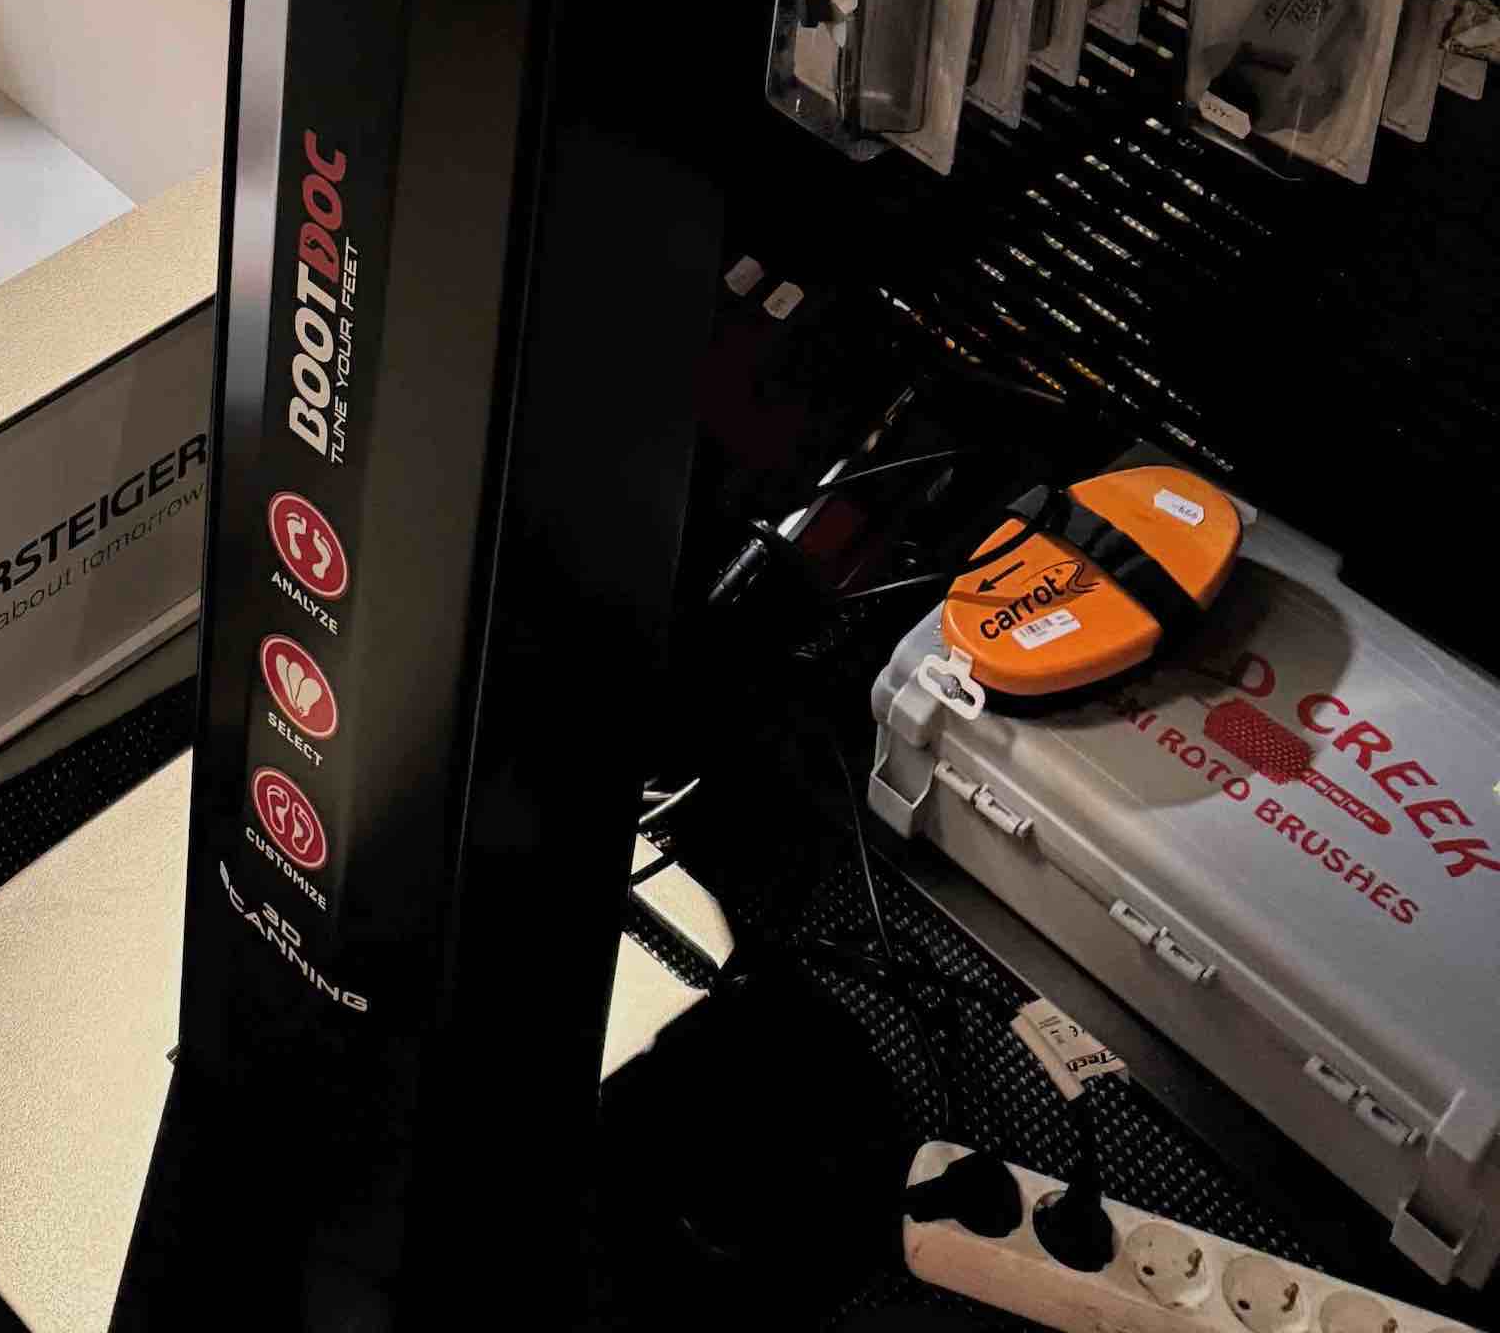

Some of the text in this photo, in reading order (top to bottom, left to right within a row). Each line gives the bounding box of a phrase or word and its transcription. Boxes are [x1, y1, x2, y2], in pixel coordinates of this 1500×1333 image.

[330, 235, 361, 466] TUNE YOUR FEET
[80, 481, 206, 577] tomorrow
[270, 568, 340, 637] ANALYZE
[979, 574, 1066, 640] carrot
[266, 709, 326, 768] SELECT
[1156, 727, 1252, 803] ROTO
[1253, 796, 1421, 927] BRUSHES
[1296, 691, 1500, 879] CREEK
[244, 824, 329, 914] CUSTOMIZE
[260, 899, 303, 948] 3D
